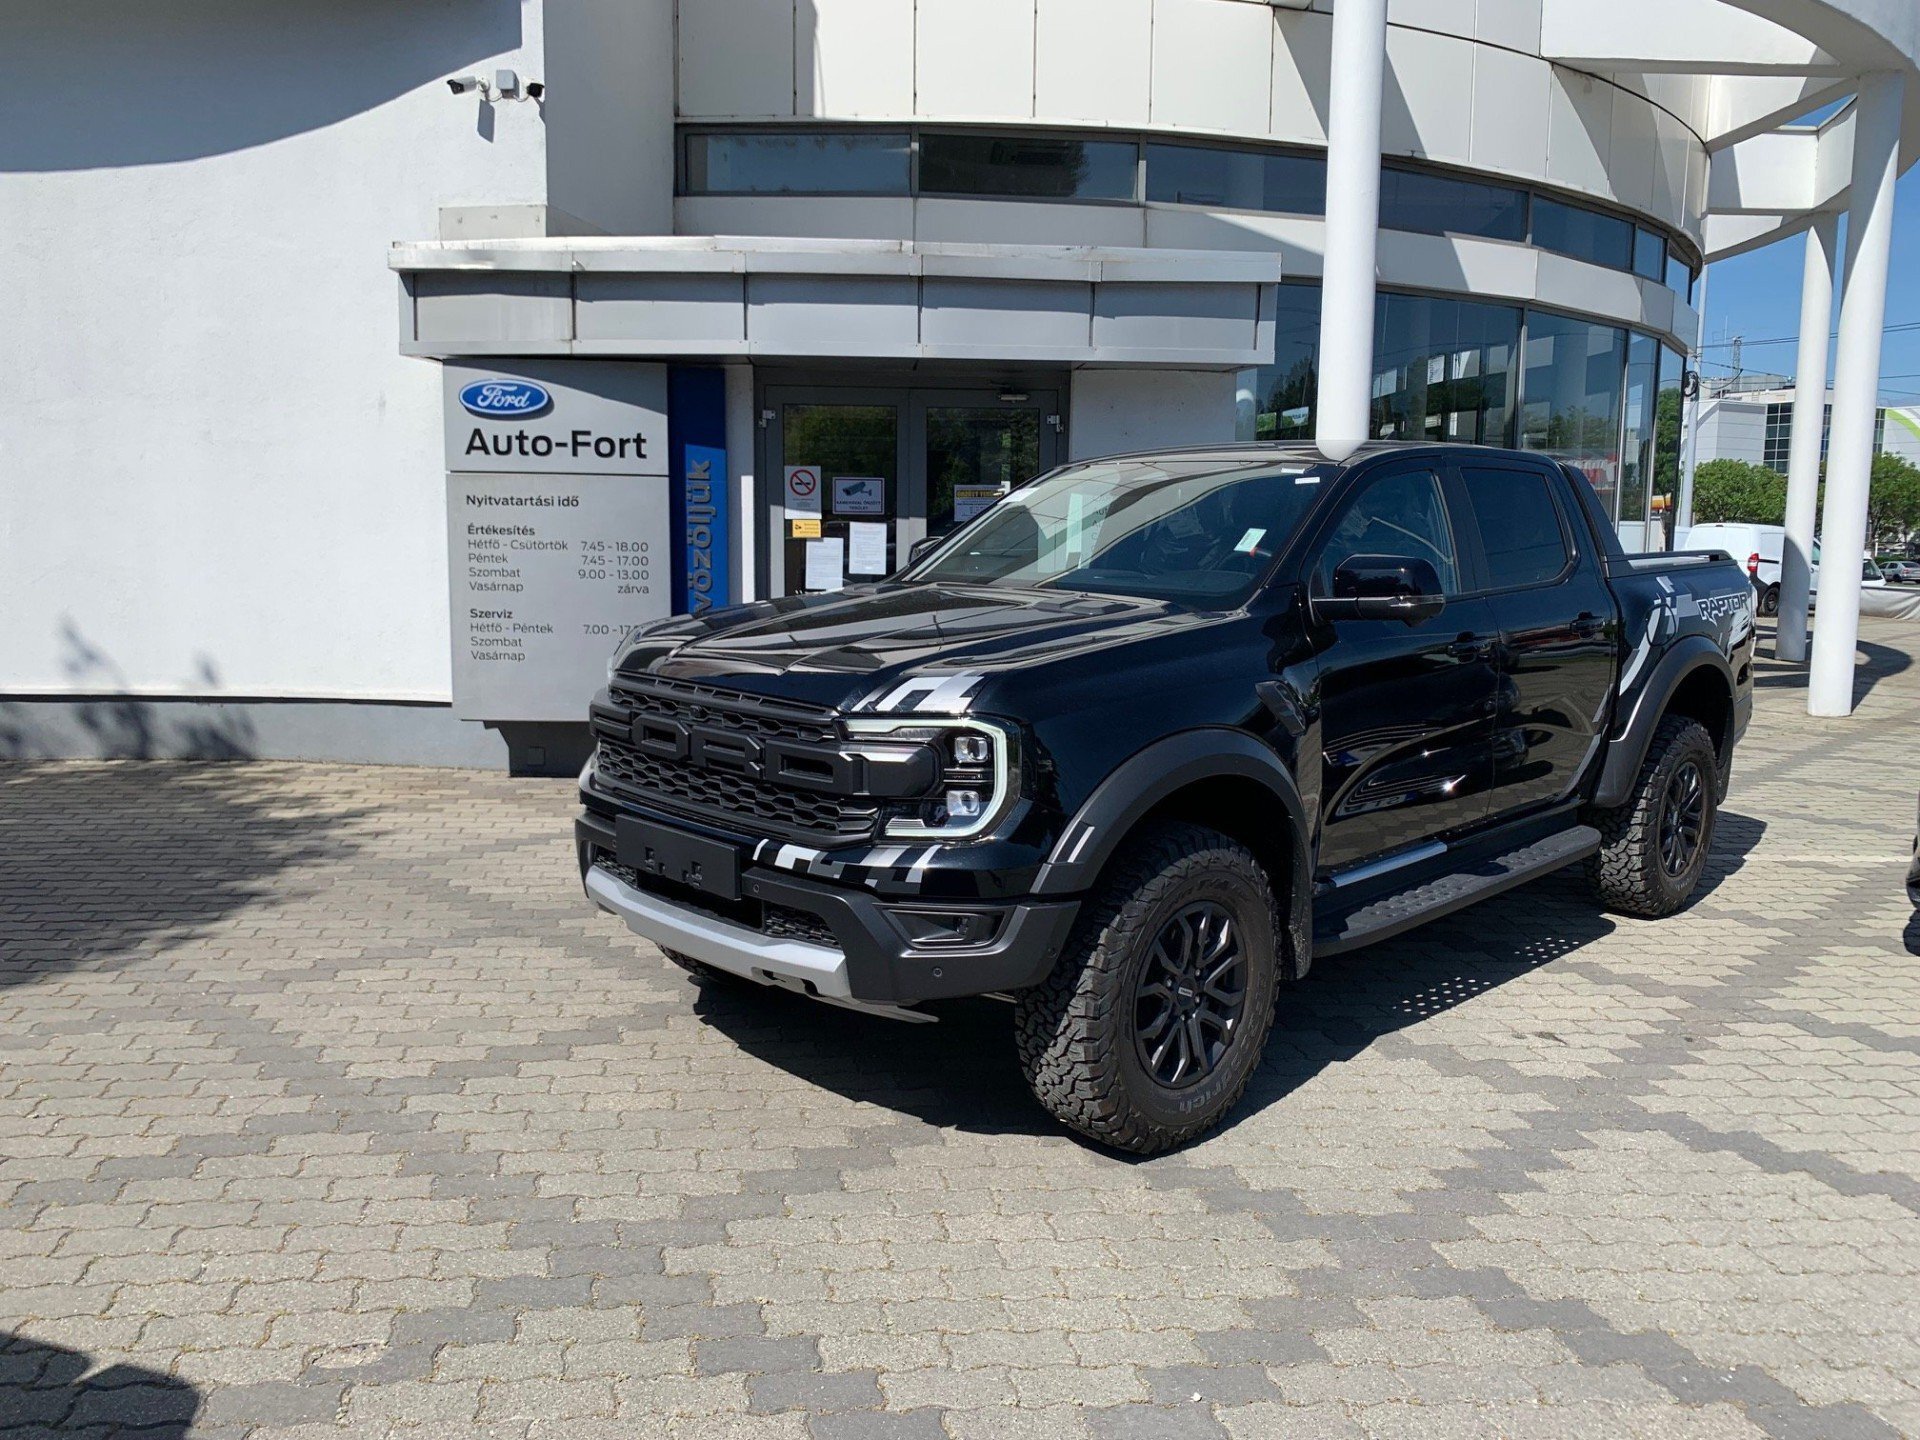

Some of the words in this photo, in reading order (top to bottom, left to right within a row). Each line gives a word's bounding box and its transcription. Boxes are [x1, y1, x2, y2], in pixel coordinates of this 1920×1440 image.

[477, 383, 530, 407] Ford
[465, 428, 647, 459] Auto-Fort
[466, 494, 554, 508] Nyitvatartási
[558, 495, 579, 507] idő
[467, 522, 536, 536] Értékesítés
[467, 539, 500, 549] Hétfő
[510, 540, 569, 550] Csütörtök
[581, 541, 605, 551] 7.45
[616, 542, 649, 552] 18.00
[468, 553, 509, 564] Péntek
[581, 555, 606, 566] 7.45
[617, 556, 649, 566] 17.00
[469, 566, 521, 578] Szombat
[578, 569, 606, 579] 9.00
[617, 570, 649, 580] 13.00
[469, 580, 524, 593] Vasárnap
[617, 584, 649, 594] zárva
[470, 608, 513, 619] Szerviz
[1697, 592, 1749, 627] RAPTOR
[512, 622, 554, 634] Péntek
[583, 624, 610, 635] 7.00
[470, 636, 522, 647] Szombat
[470, 650, 526, 662] Vasárnap
